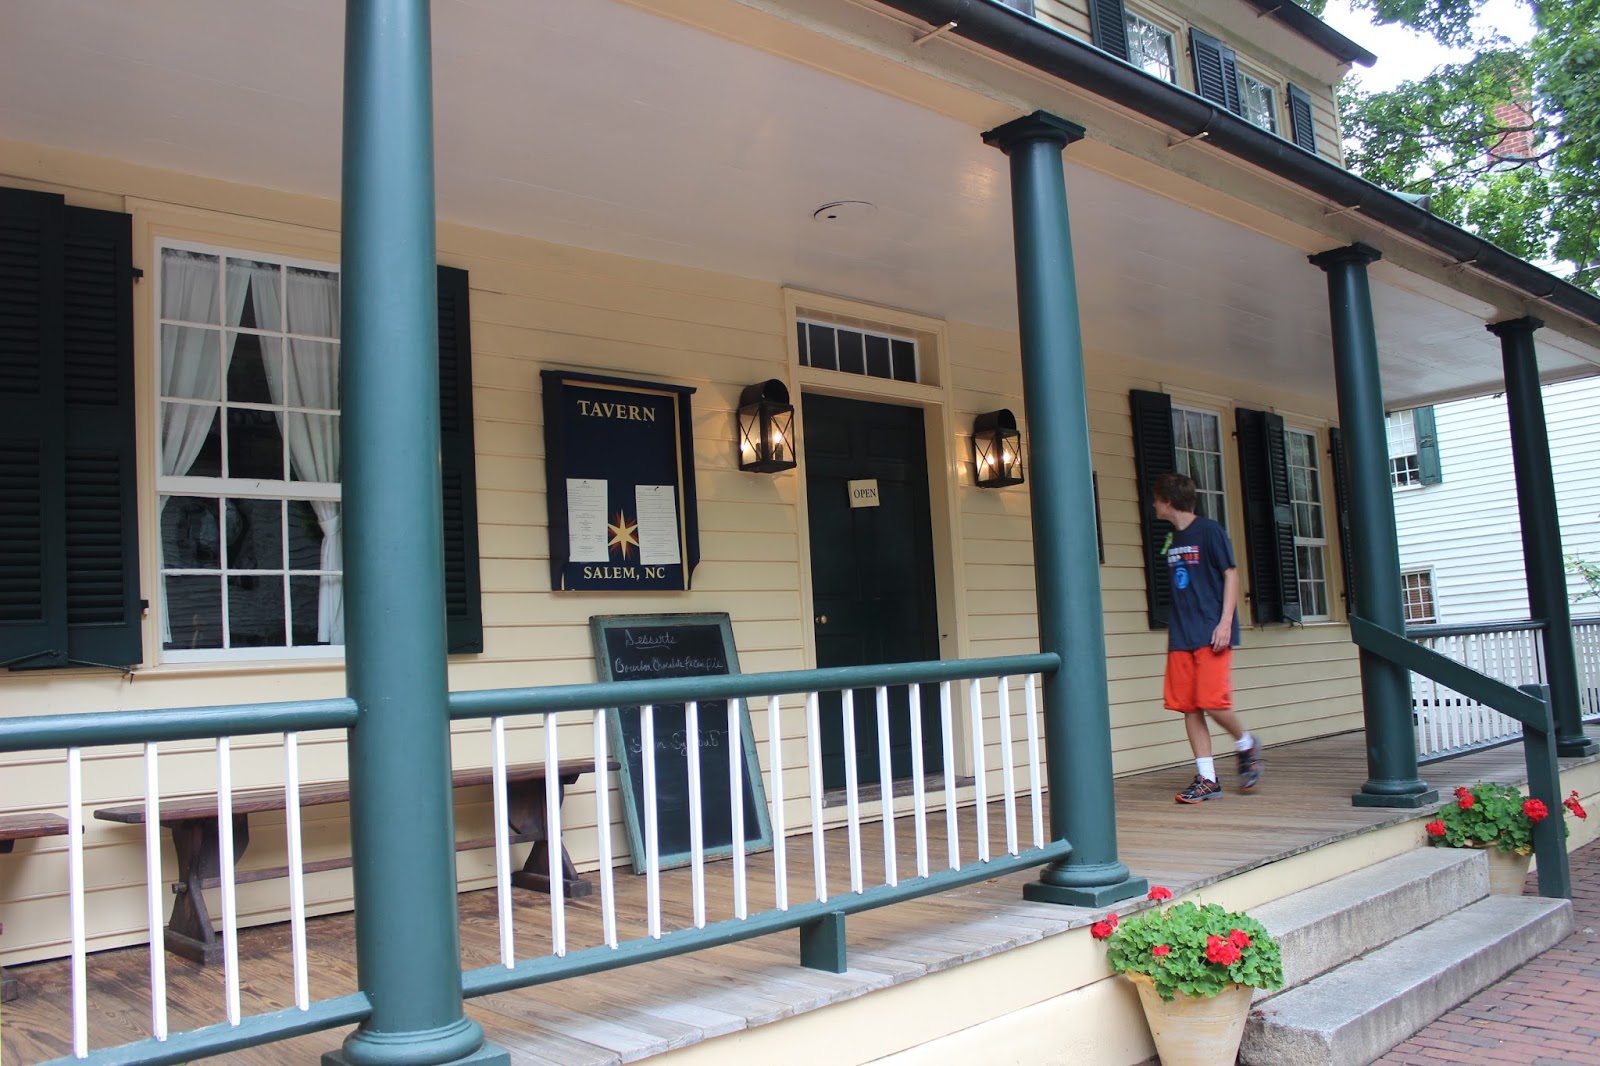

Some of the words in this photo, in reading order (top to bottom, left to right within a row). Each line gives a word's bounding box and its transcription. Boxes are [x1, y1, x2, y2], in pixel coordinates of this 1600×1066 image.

[577, 400, 655, 422] TAVERN
[853, 488, 877, 499] OPEN
[583, 566, 640, 581] SALEM,
[645, 566, 666, 579] NC
[625, 629, 677, 647] Desserts
[615, 658, 652, 673] Bourbon
[653, 657, 684, 672] Chocolate
